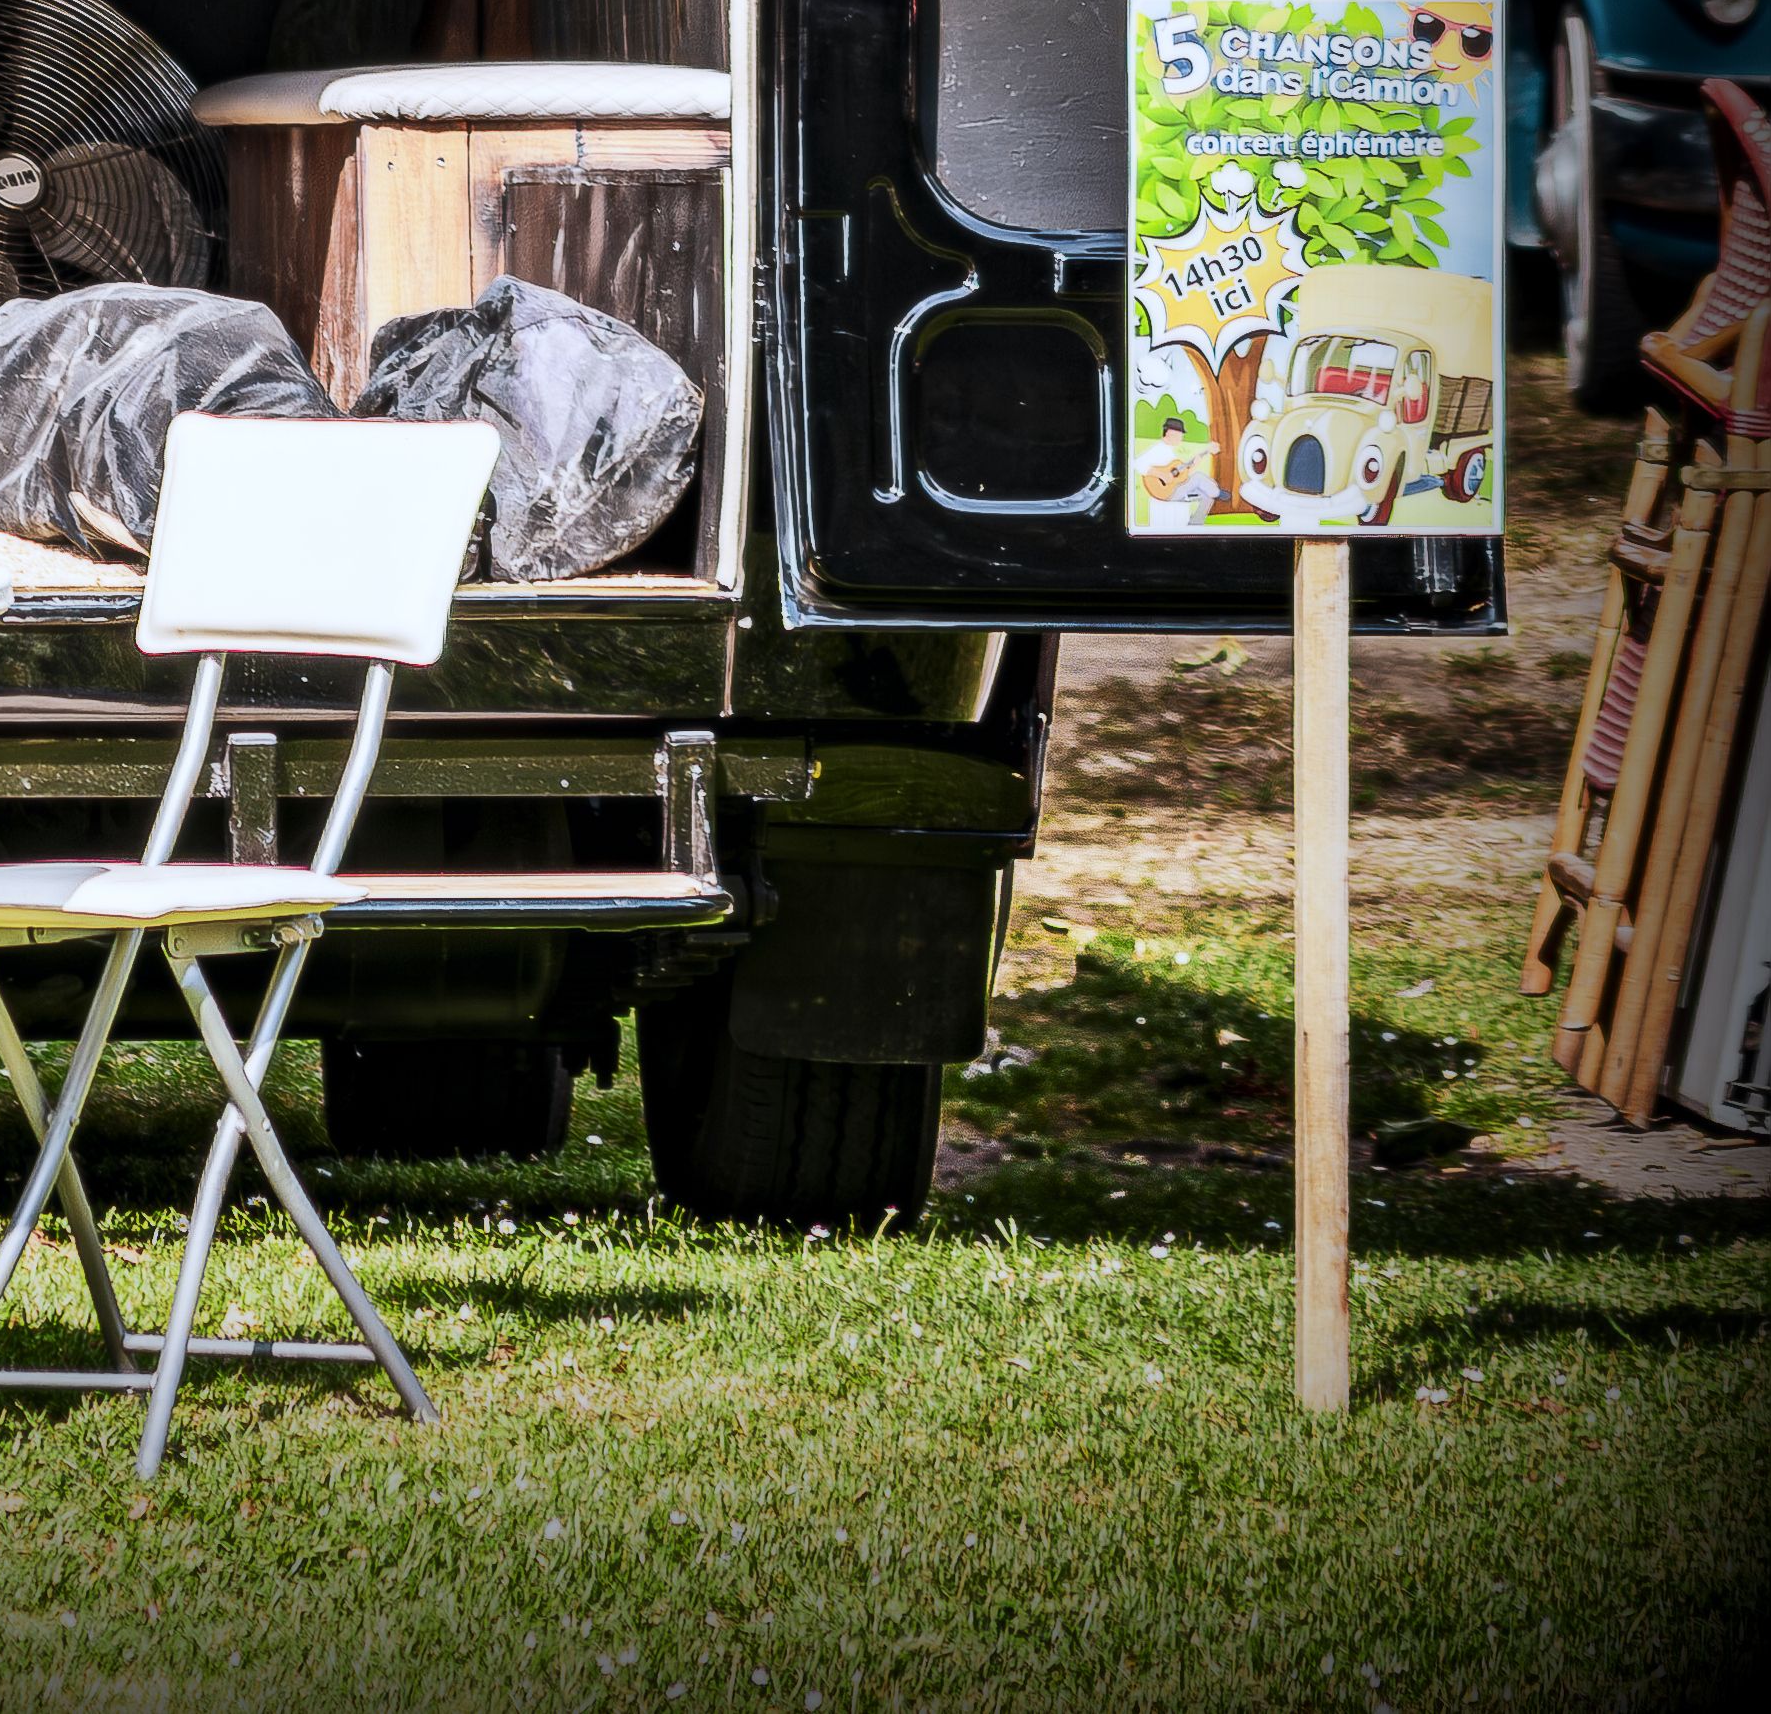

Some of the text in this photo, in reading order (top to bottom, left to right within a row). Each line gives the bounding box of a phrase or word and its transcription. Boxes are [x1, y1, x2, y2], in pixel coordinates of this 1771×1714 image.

[1152, 13, 1434, 96] 5 CHANSONS
[1216, 65, 1303, 98] dans
[1186, 130, 1445, 162] concert éphémère
[1164, 234, 1265, 300] 14h30
[1213, 279, 1254, 318] ici
